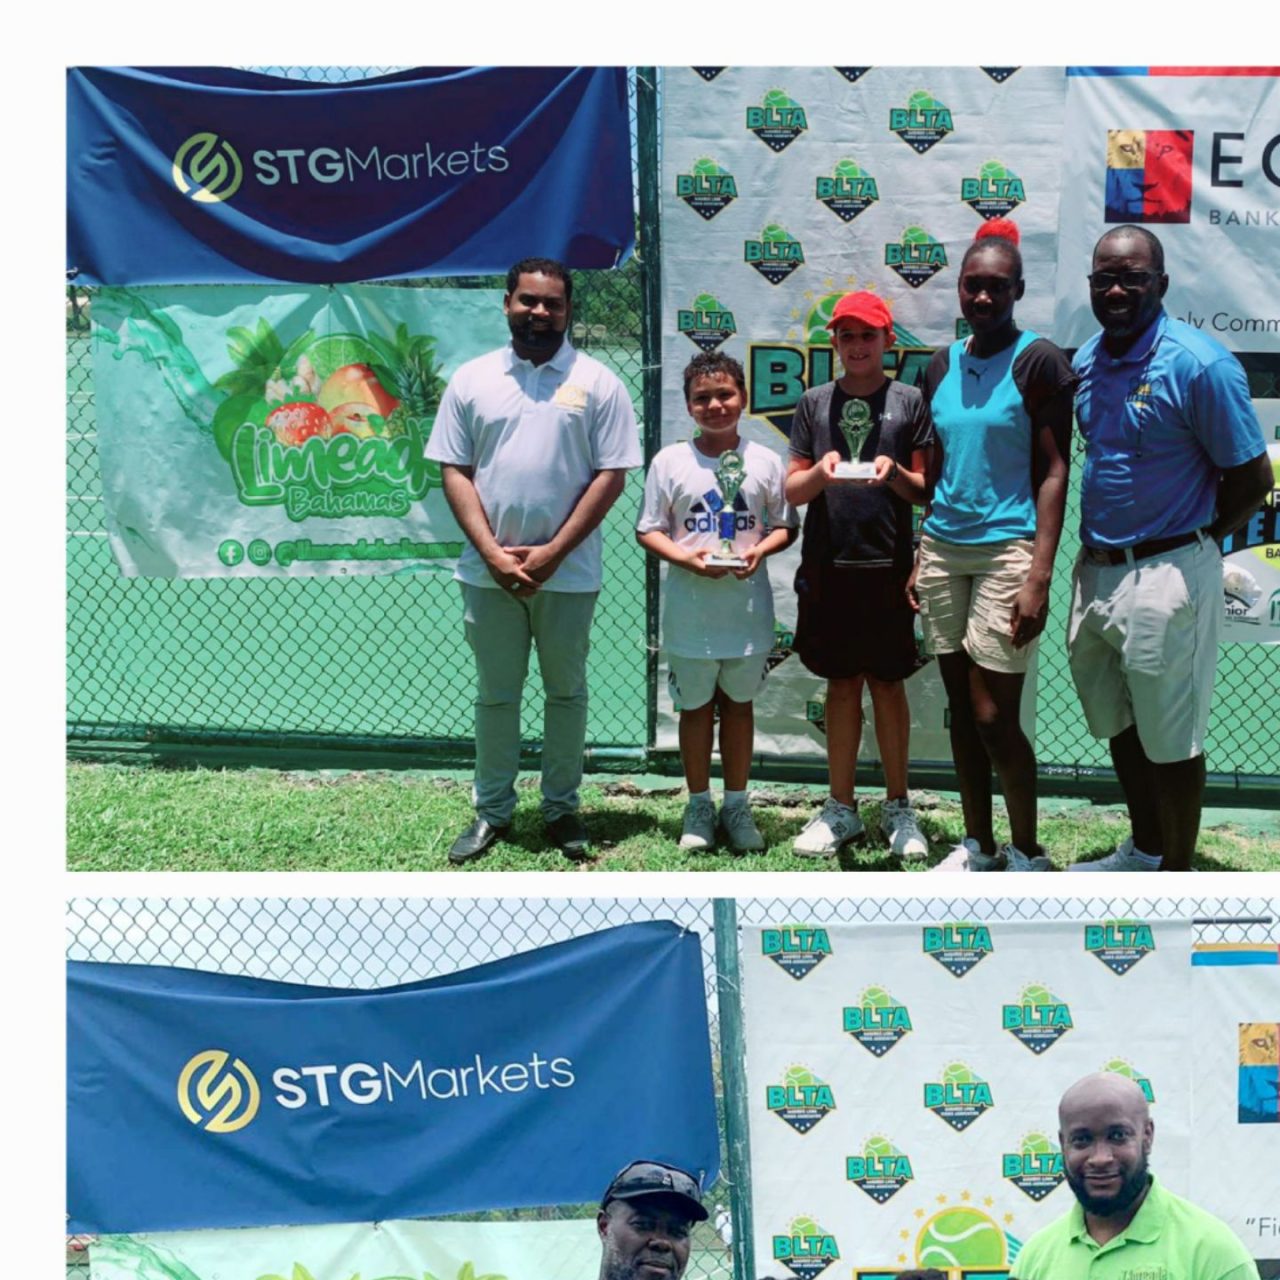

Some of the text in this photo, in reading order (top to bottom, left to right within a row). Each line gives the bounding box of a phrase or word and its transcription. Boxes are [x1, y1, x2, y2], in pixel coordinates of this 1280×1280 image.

[746, 106, 808, 129] BLTA
[889, 108, 954, 131] BLTA
[253, 142, 510, 186] STGMarkets
[676, 175, 738, 198] BLTA
[816, 176, 879, 201] BLTA
[961, 178, 1026, 201] BLTA
[1209, 209, 1280, 226] BANK
[744, 240, 805, 263] BLTA
[885, 243, 948, 266] BLTA
[678, 310, 737, 332] BLTA
[288, 487, 410, 519] Bahamas
[684, 512, 756, 533] adias
[761, 928, 833, 955] BLTA
[923, 926, 994, 953] BLTA
[1084, 924, 1155, 951] BLTA
[843, 1005, 912, 1033] BLTA
[1003, 1003, 1073, 1030] BLTA
[273, 1052, 575, 1110] STGMarkets
[766, 1084, 837, 1111] BLTA
[924, 1082, 994, 1109] BLTA
[846, 1155, 914, 1181] BLTA
[773, 1235, 840, 1260] BLTA
